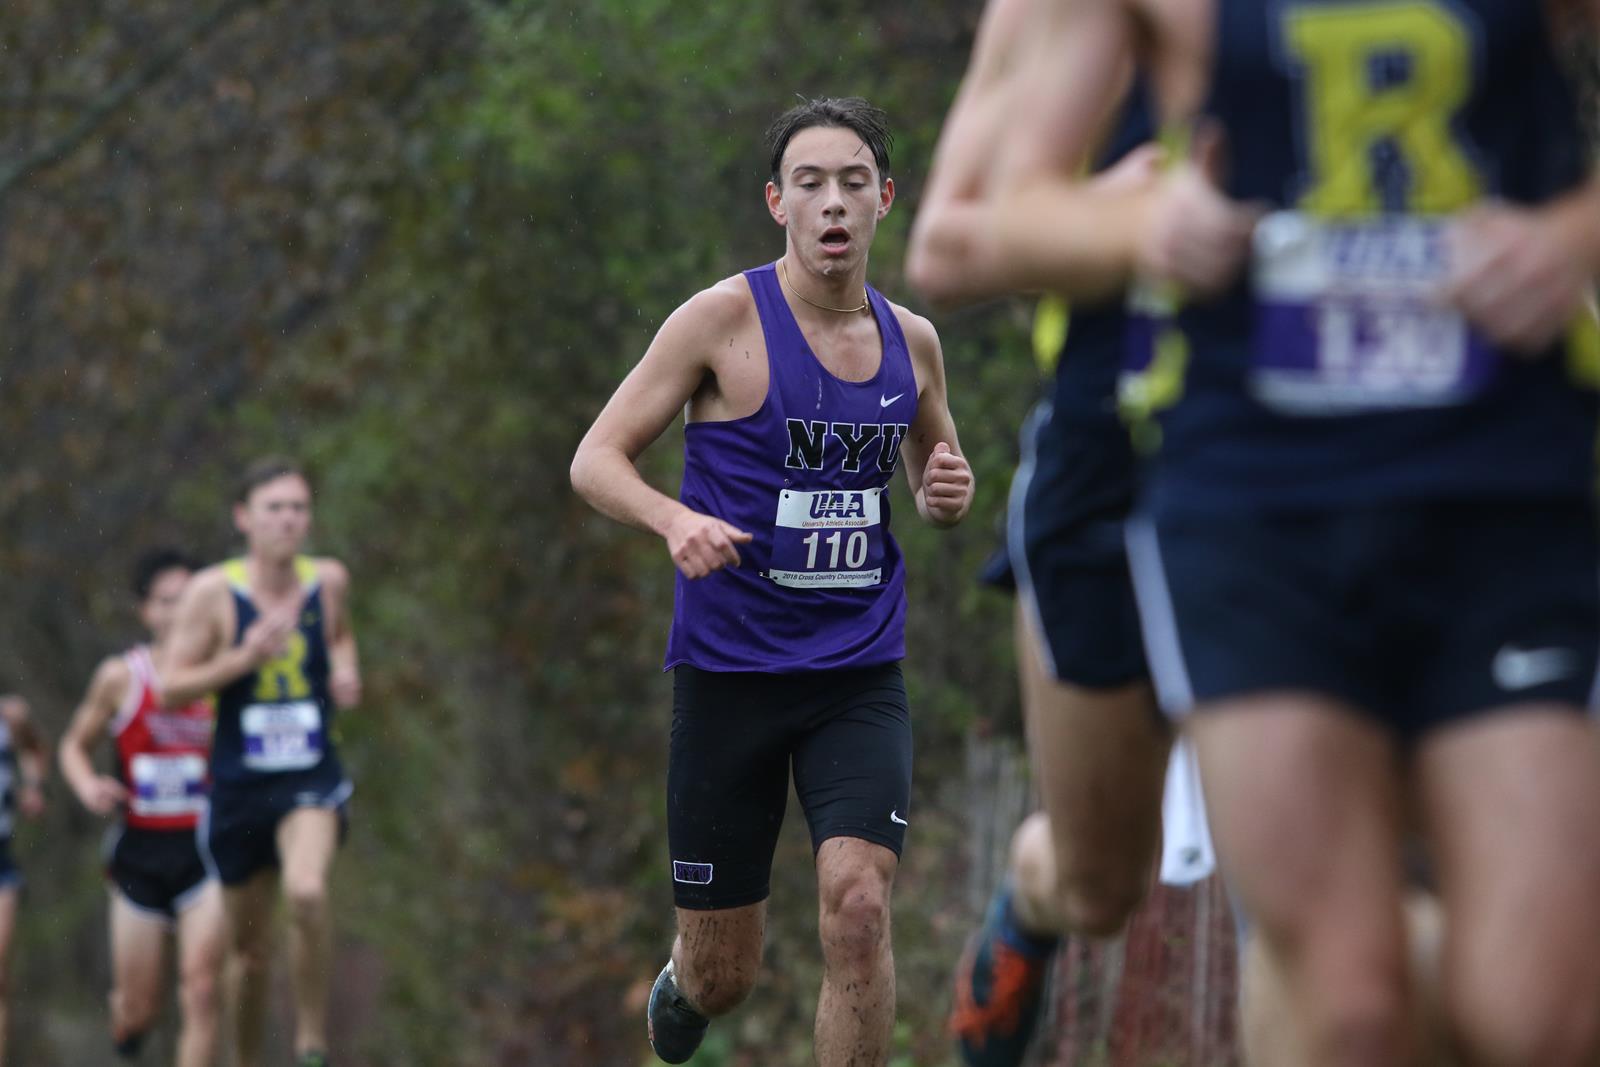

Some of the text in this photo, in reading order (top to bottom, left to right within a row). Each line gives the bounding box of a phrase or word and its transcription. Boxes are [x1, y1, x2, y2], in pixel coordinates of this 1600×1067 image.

[1280, 2, 1480, 216] R
[785, 418, 908, 473] NYU
[809, 492, 865, 519] UAA
[803, 530, 868, 569] 110
